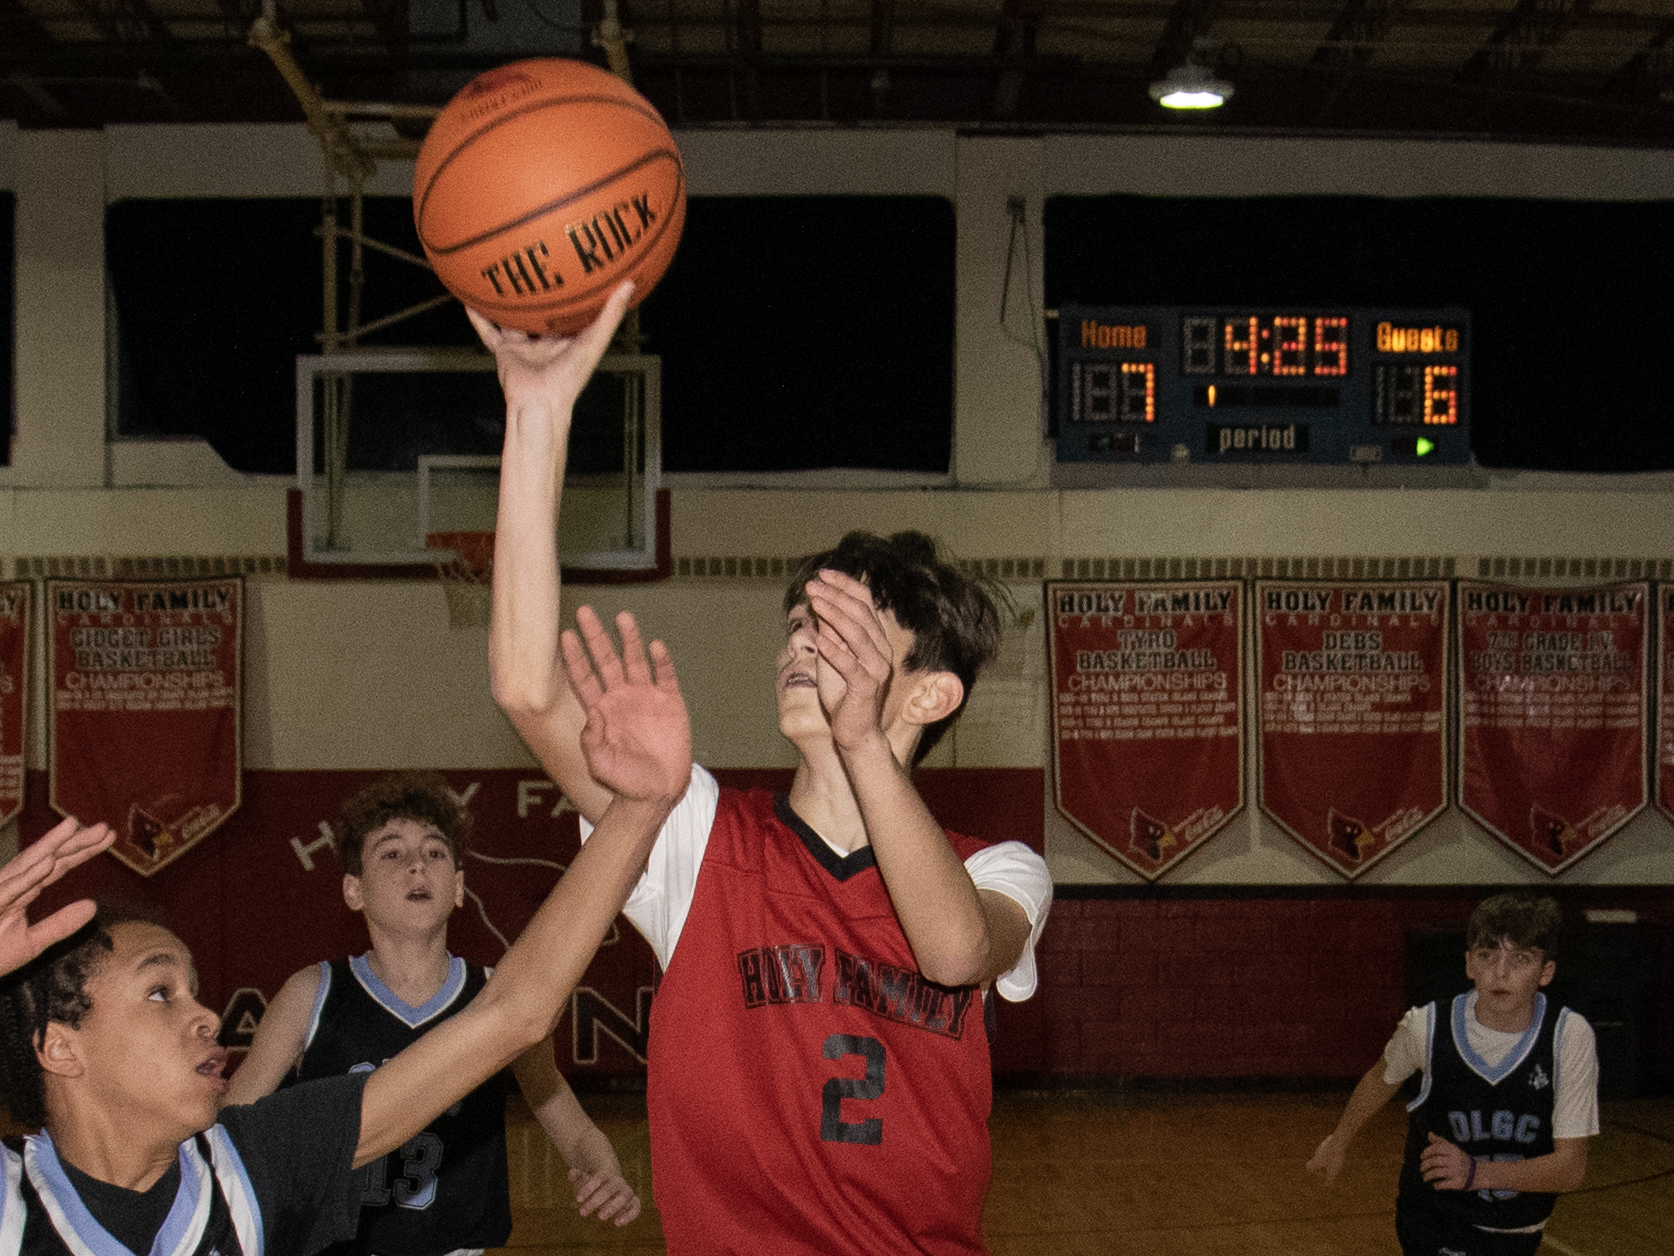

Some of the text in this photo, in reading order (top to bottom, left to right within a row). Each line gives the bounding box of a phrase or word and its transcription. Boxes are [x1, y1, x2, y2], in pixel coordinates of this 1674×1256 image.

[481, 193, 656, 296] THE ROCK
[1081, 320, 1147, 349] Home
[1224, 316, 1348, 376] 4:25
[1424, 364, 1458, 424] 6
[1219, 423, 1296, 455] period
[57, 588, 232, 613] HOLY FAMILY
[1058, 590, 1232, 615] HOLY FAMILY
[1265, 589, 1440, 613] HOLY FAMILY
[1467, 591, 1641, 613] HOLY FAMILY
[1323, 630, 1383, 651] DEBS
[76, 649, 216, 671] BASKETBALL
[1077, 649, 1217, 672] BASKETBALL
[1282, 651, 1424, 673] BASKETBALL
[1521, 651, 1631, 674] BASKETBALL
[1068, 672, 1228, 691] CHAMPIONSHIPS
[1273, 673, 1431, 692] CHAMPIONSHIPS
[833, 947, 973, 1040] FAMILY
[820, 1033, 886, 1145] 2
[1448, 1109, 1541, 1143] OLGC
